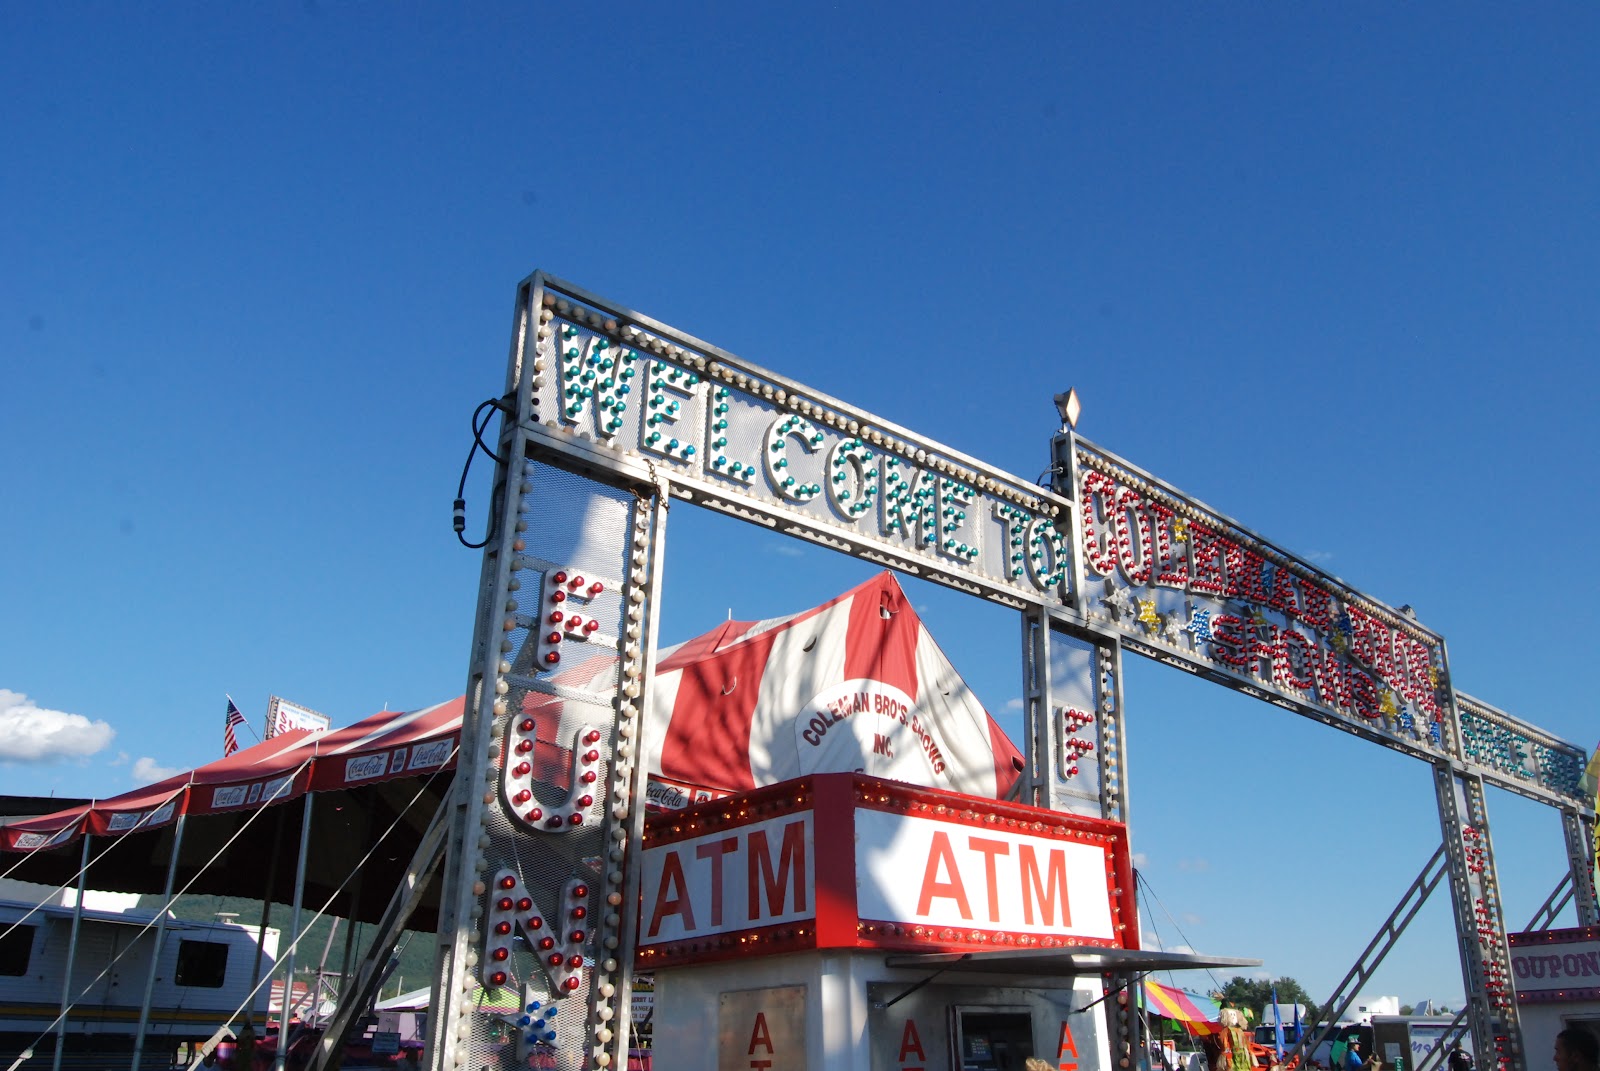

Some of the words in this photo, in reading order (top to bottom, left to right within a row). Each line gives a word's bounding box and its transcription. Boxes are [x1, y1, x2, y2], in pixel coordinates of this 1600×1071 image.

[558, 322, 979, 563] WELCOME
[993, 502, 1068, 591] TO
[1081, 469, 1332, 637] COLEMAN
[1208, 612, 1381, 719] SHOWS
[803, 692, 871, 747] COLEMAN
[912, 714, 946, 775] SHOWS
[873, 732, 894, 759] INC.
[648, 820, 807, 937] ATM
[916, 830, 1072, 927] ATM
[1511, 951, 1600, 979] OUPON
